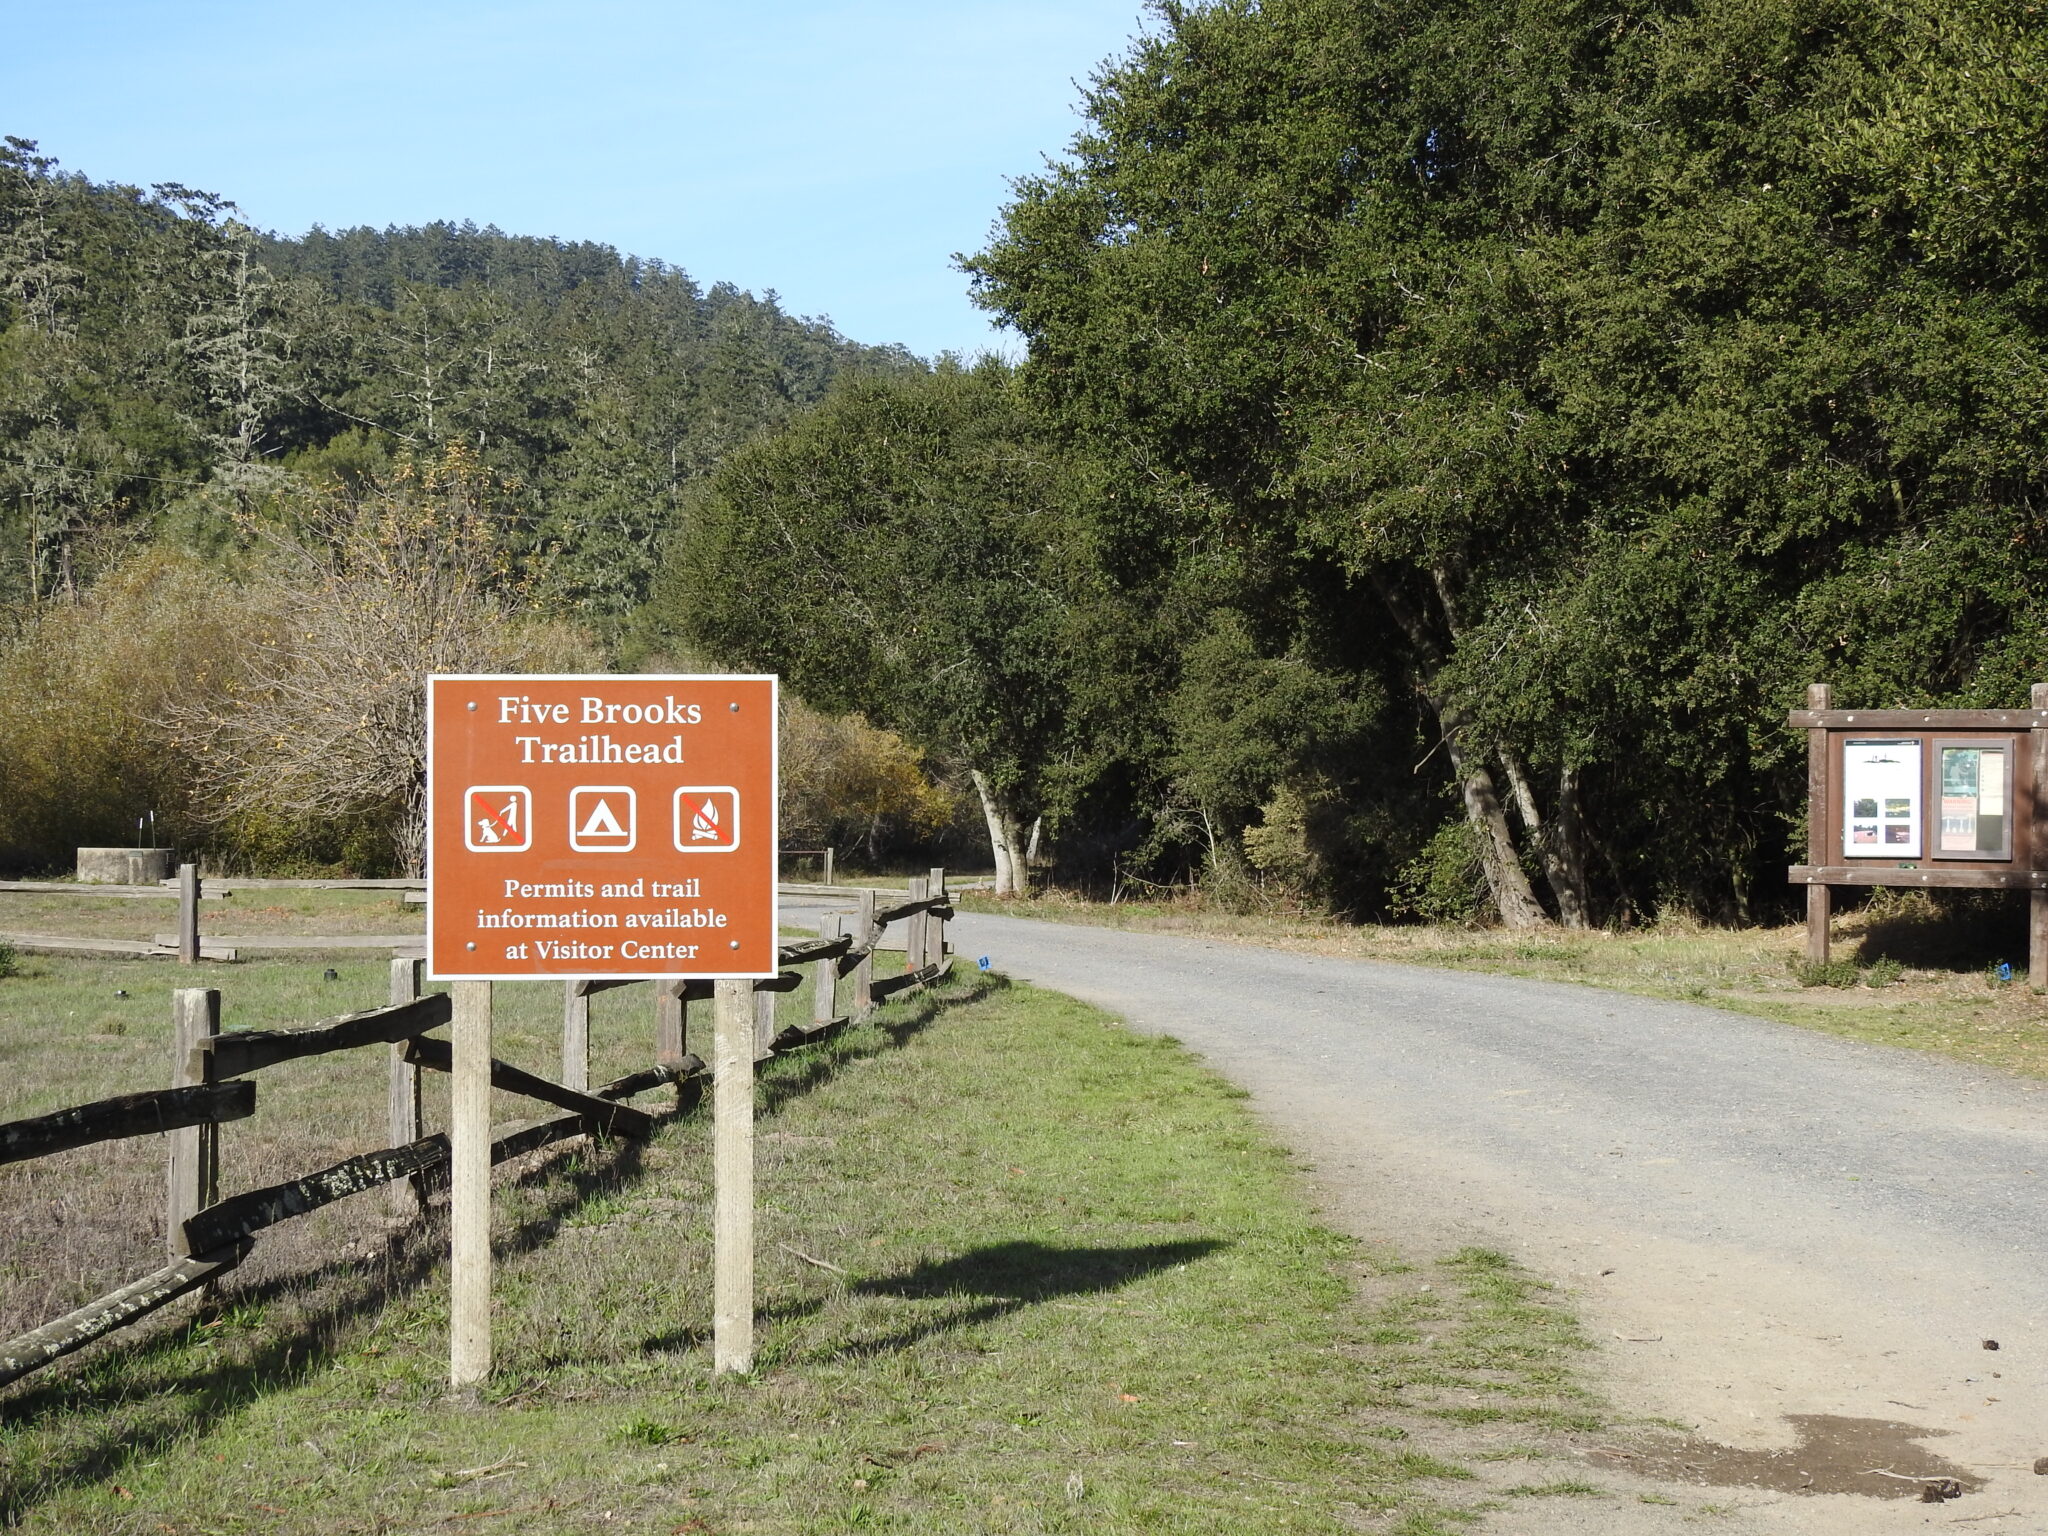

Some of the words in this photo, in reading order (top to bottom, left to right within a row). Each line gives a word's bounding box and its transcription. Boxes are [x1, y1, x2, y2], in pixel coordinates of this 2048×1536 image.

[498, 696, 569, 724] Five
[580, 696, 701, 724] Brooks
[516, 735, 684, 763] Trailhead
[505, 879, 594, 898] Permits
[601, 878, 644, 898] and
[652, 878, 700, 898] trail
[478, 909, 618, 928] information
[626, 909, 726, 928] available
[506, 943, 528, 959] at
[535, 941, 613, 959] Visitor
[621, 941, 698, 959] Center
